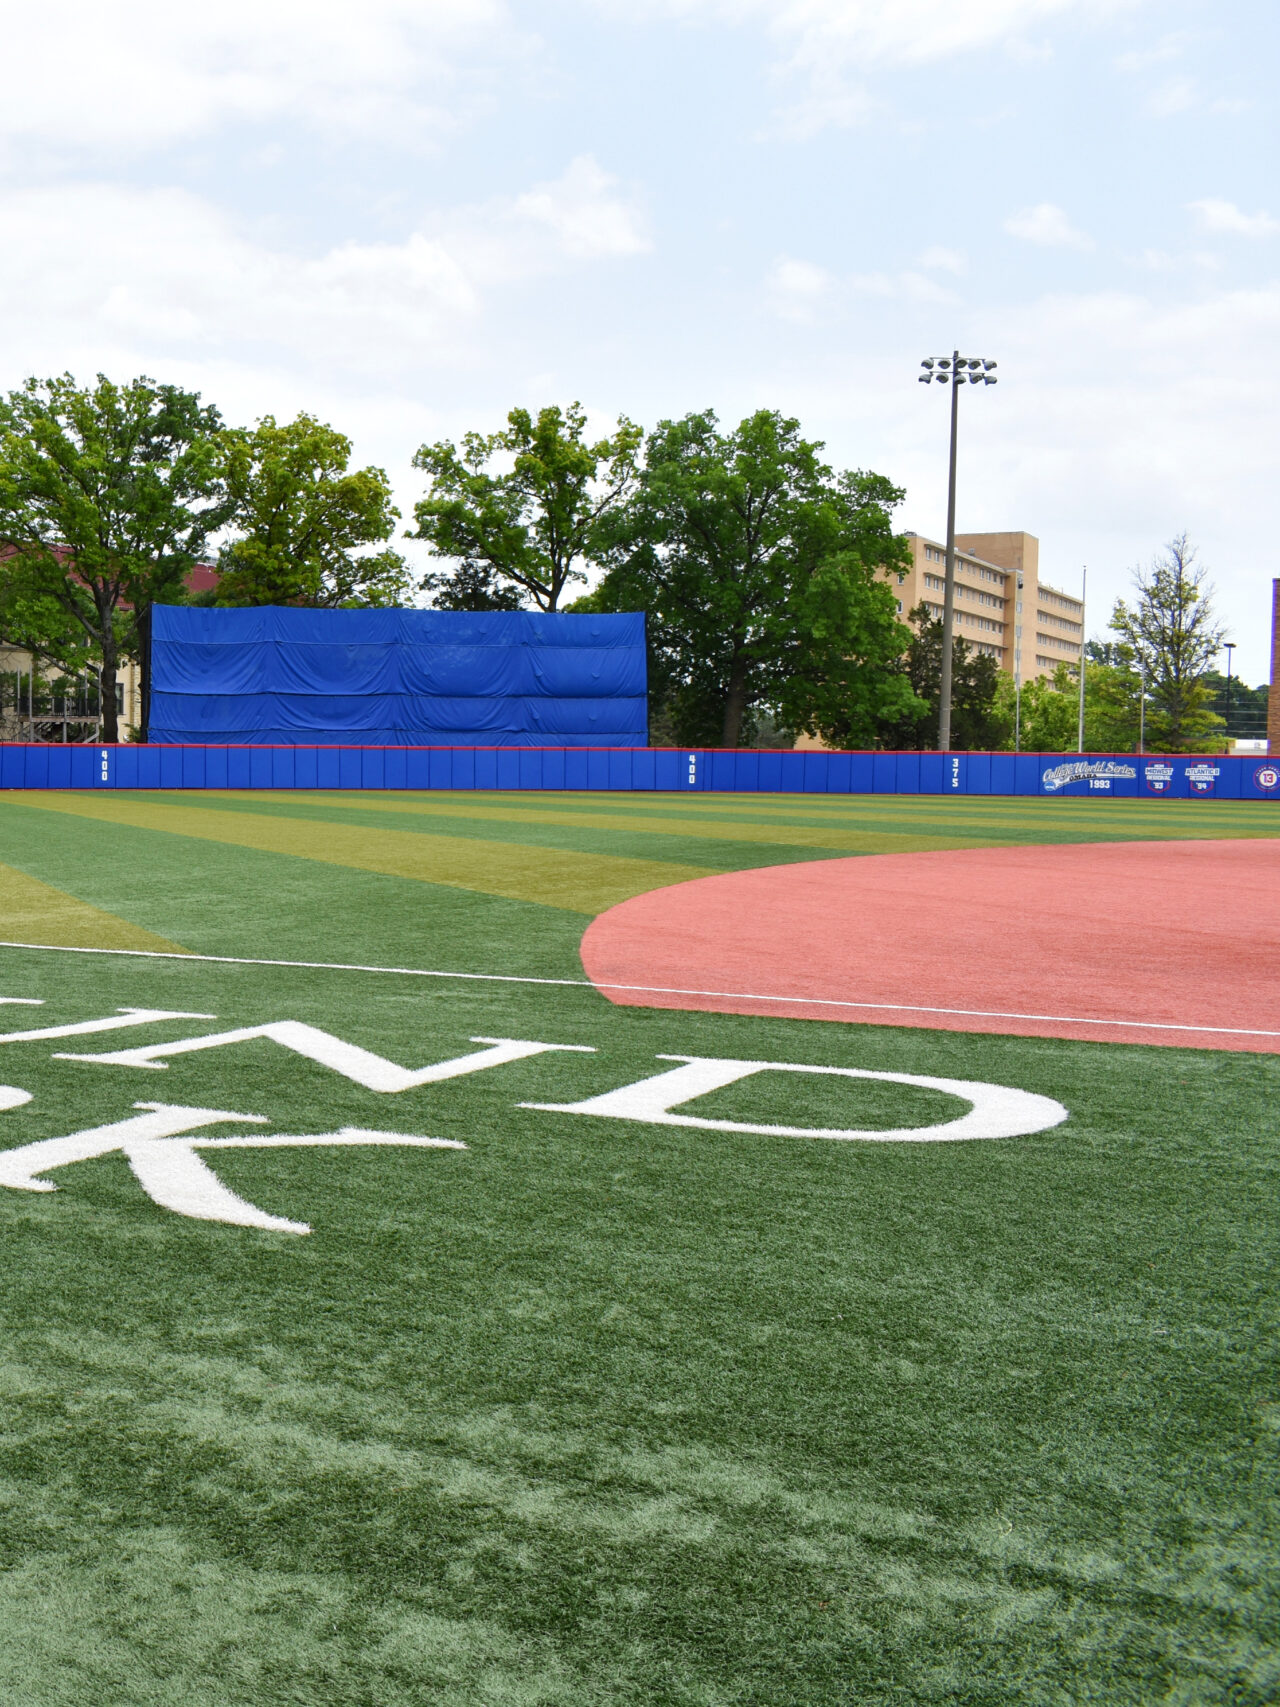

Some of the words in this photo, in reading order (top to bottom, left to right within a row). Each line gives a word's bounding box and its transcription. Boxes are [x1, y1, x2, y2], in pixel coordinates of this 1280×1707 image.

[688, 754, 696, 784] 400
[1043, 764, 1073, 782] College
[1074, 761, 1105, 773] World
[1106, 762, 1136, 776] Series
[1186, 768, 1213, 776] ATLANTIC
[1069, 773, 1097, 781] OMAHA
[1263, 774, 1274, 783] 13
[1089, 780, 1111, 789] 1993
